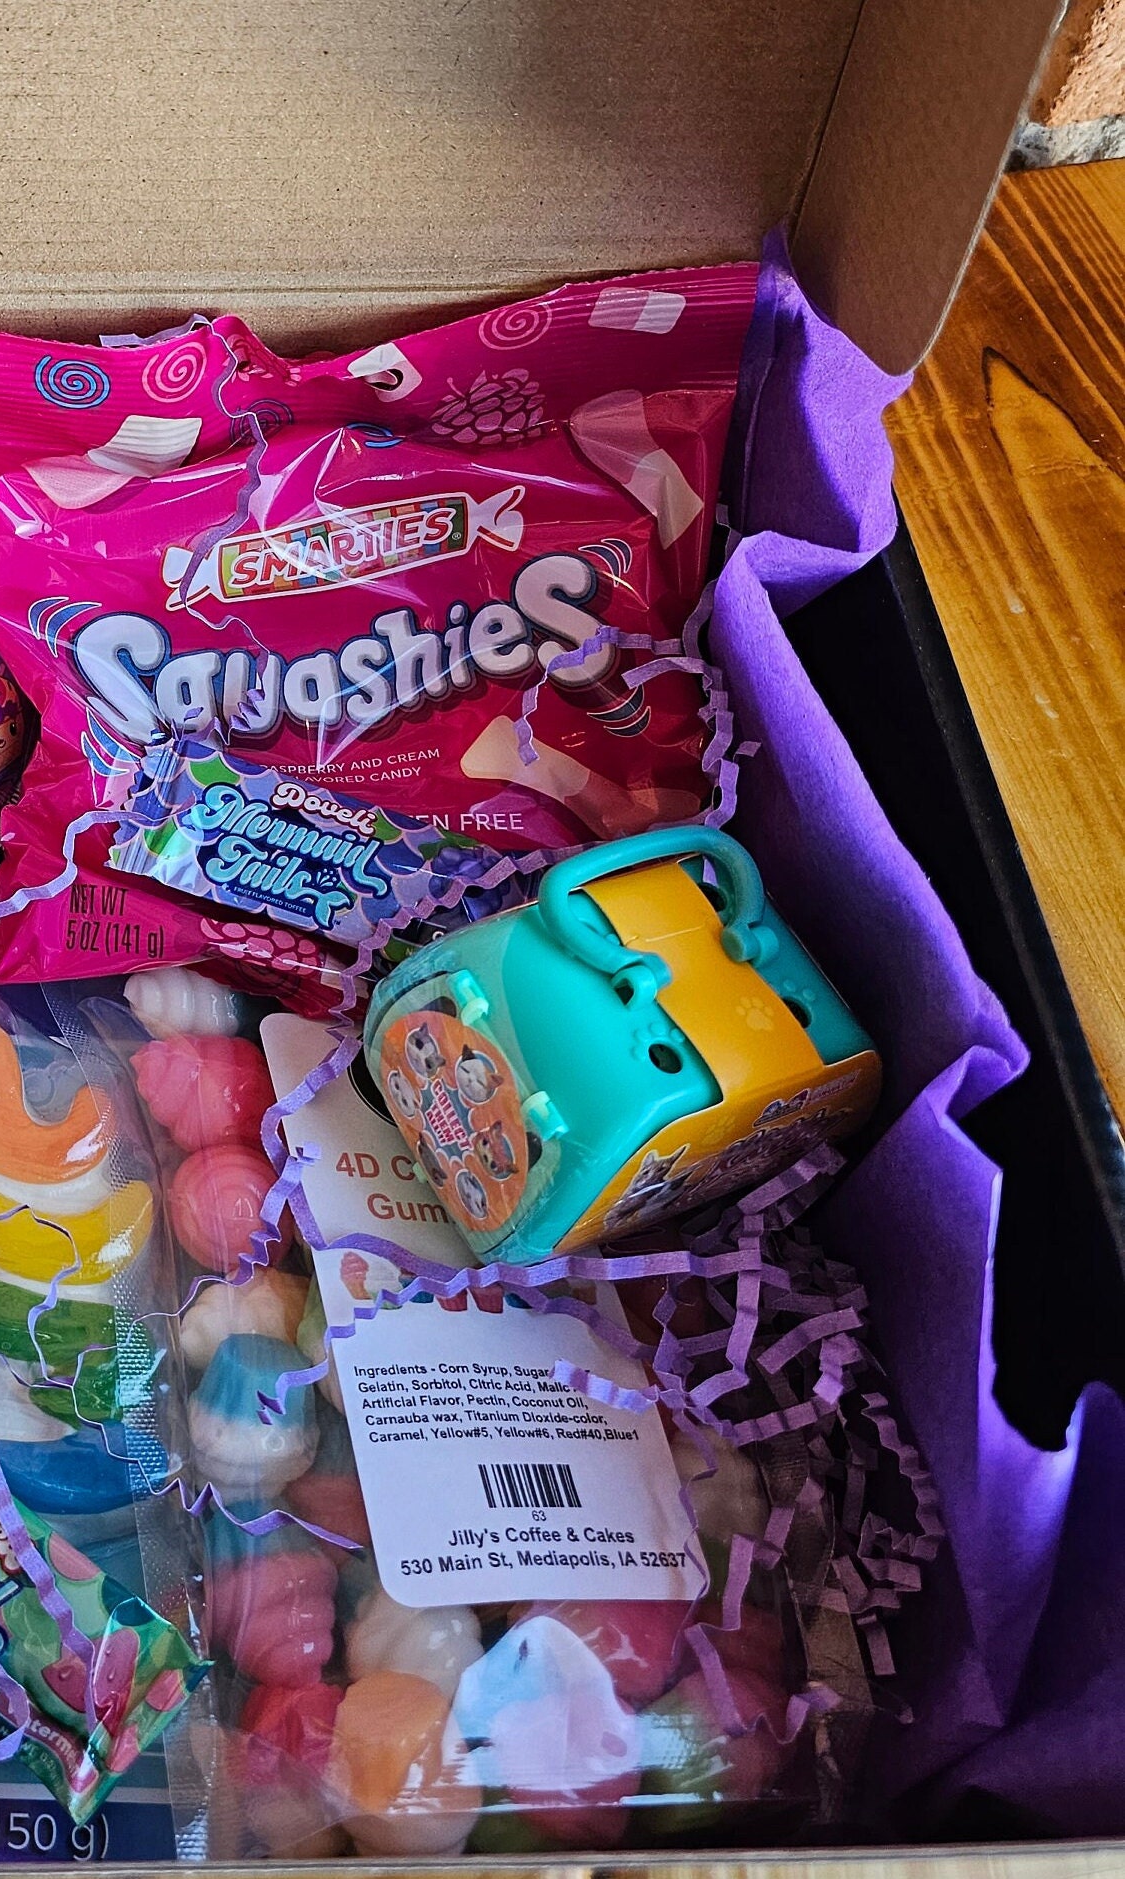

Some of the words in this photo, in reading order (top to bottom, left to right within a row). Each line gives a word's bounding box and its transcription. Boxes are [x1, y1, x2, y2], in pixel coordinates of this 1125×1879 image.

[230, 507, 455, 587] SMARTIES
[351, 757, 382, 770] AND
[387, 749, 440, 765] CREAM
[295, 774, 365, 784] LAVORED
[370, 767, 421, 782] CANDY
[273, 783, 375, 835] Doveli
[460, 813, 525, 831] FREE
[190, 784, 387, 896] Mermaid
[205, 835, 333, 908] Tails
[70, 884, 97, 914] NET
[101, 885, 129, 916] WT
[284, 902, 307, 913] TOFFEE
[66, 920, 77, 950] 5
[80, 921, 100, 952] OZ
[105, 922, 140, 956] (141
[147, 925, 164, 959] g)
[432, 1079, 471, 1150] COLLECT
[432, 1102, 455, 1143] THEM
[336, 1152, 380, 1178] 4D
[391, 1155, 415, 1181] C
[367, 1193, 449, 1224] Gum
[354, 1364, 427, 1378] Ingredients
[439, 1363, 469, 1374] Corn
[472, 1363, 512, 1378] Syrup,
[358, 1381, 409, 1393] Gelatin,
[412, 1379, 467, 1391] Sorbitol,
[469, 1379, 502, 1390] Citric
[505, 1381, 535, 1393] Acid,
[537, 1381, 570, 1393] Malic
[362, 1396, 416, 1409] Artificial
[419, 1395, 464, 1407] Flavor,
[466, 1394, 510, 1408] Pectin,
[512, 1396, 564, 1408] Coconut
[566, 1396, 589, 1410] Oil,
[365, 1412, 429, 1426] Carnauba
[432, 1413, 463, 1423] wax,
[464, 1410, 519, 1422] Titanium
[523, 1411, 607, 1425] Dioxide-color,
[369, 1428, 428, 1443] Caramel,
[431, 1426, 493, 1439] Yellow#5,
[495, 1426, 554, 1440] Yellow#6,
[532, 1511, 547, 1522] 63
[448, 1528, 500, 1548] Jilly's
[505, 1527, 562, 1543] Coffee
[567, 1528, 579, 1542] &
[584, 1528, 635, 1543] Cakes
[400, 1558, 433, 1575] 530
[439, 1552, 482, 1573] Main
[488, 1552, 513, 1569] St,
[517, 1550, 615, 1569] Mediapolis,
[619, 1551, 638, 1567] IA
[641, 1552, 686, 1568] 52637
[72, 1813, 109, 1862] g)
